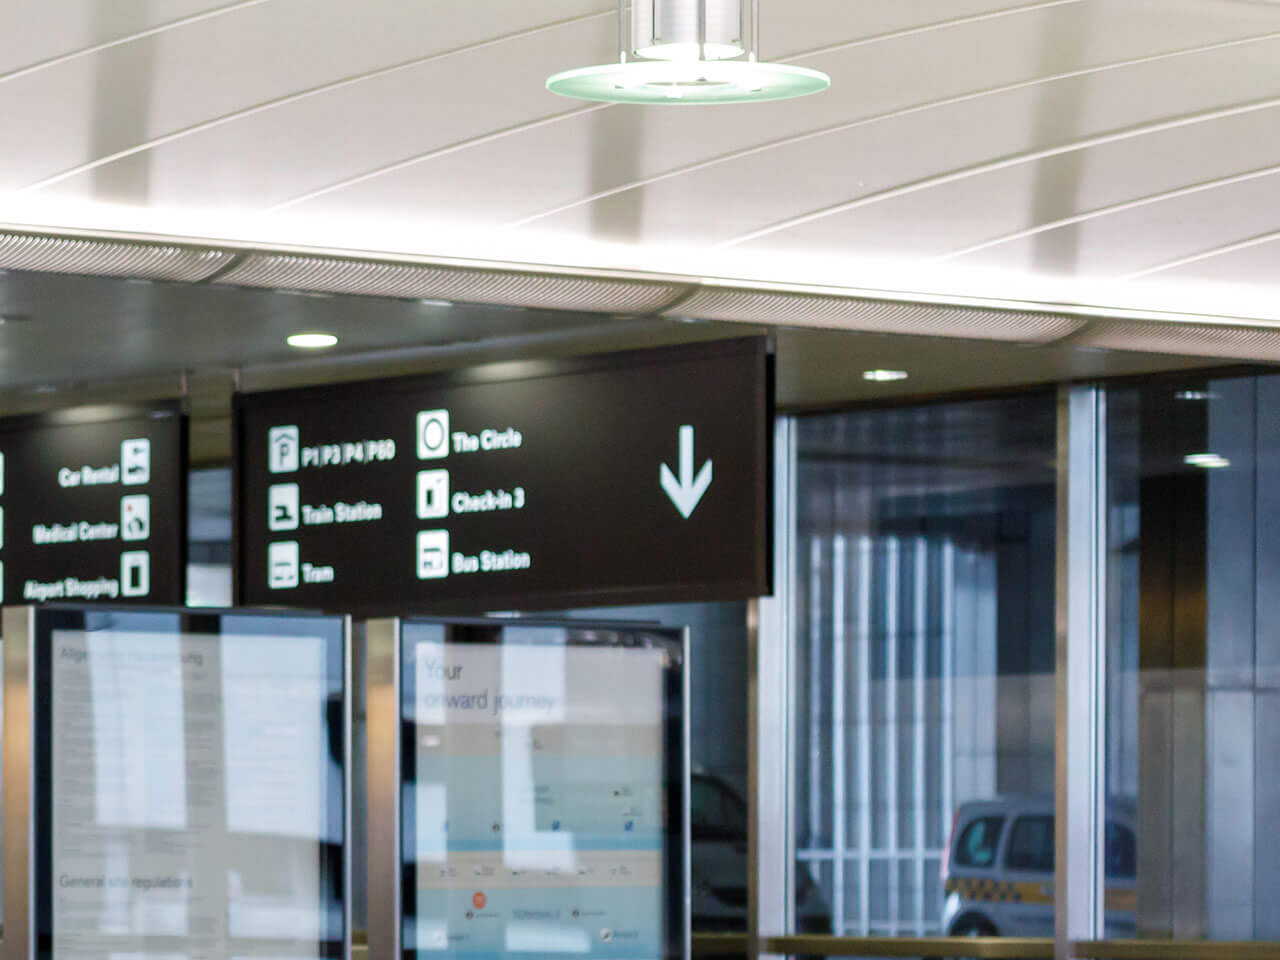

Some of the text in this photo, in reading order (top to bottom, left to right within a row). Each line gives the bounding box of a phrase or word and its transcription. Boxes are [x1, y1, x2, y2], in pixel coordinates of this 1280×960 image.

[452, 428, 522, 454] The Circle
[58, 464, 119, 488] Car Rental
[452, 488, 525, 514] Check-in 3
[302, 501, 382, 526] Train Station
[33, 521, 118, 545] Medical Center
[302, 563, 334, 583] Tram
[452, 550, 530, 574] Bus Station
[65, 577, 119, 600] Shopping
[425, 659, 462, 680] Your
[424, 691, 554, 714] onward journey
[59, 875, 105, 888] General
[131, 875, 193, 890] regulations
